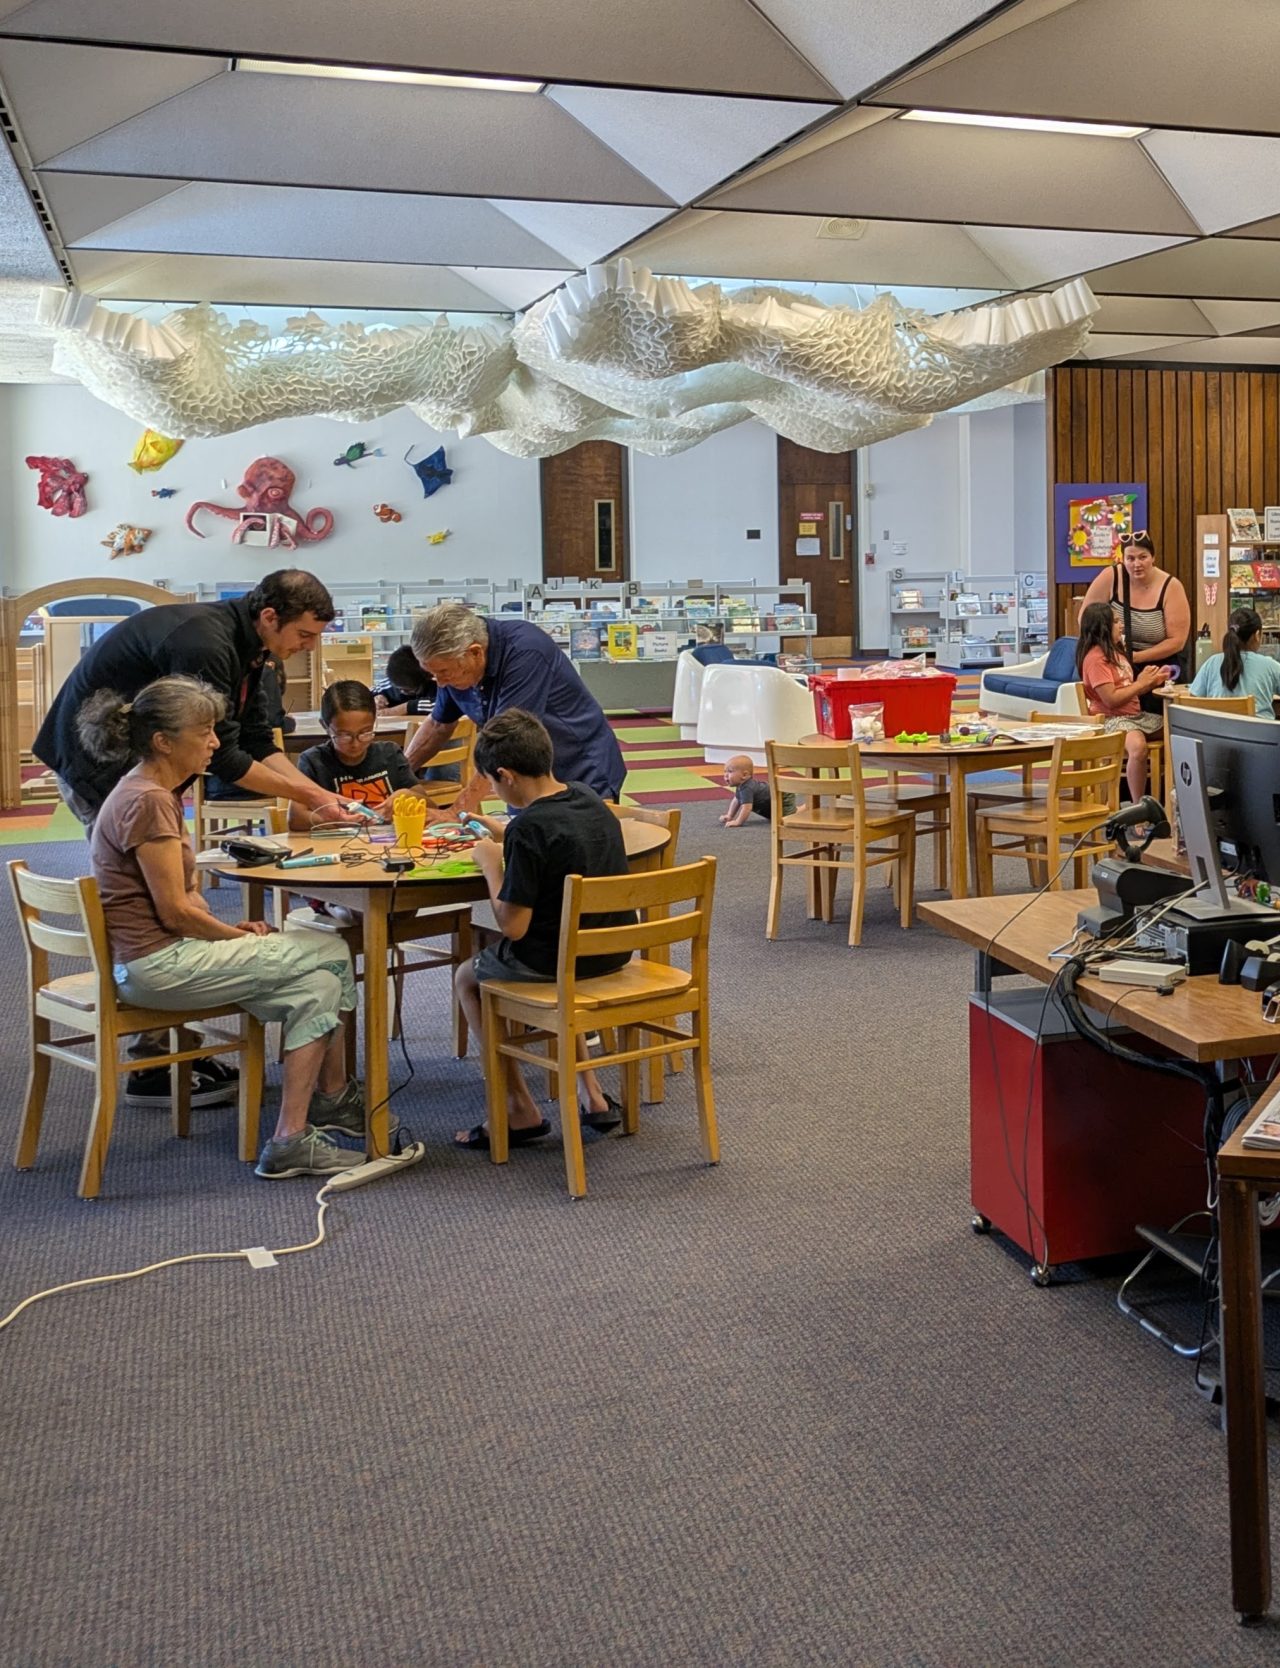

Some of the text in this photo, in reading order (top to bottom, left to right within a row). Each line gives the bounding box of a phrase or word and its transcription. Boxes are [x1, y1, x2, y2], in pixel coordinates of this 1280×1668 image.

[895, 569, 903, 579] S
[955, 573, 962, 582] L
[551, 580, 558, 590] J
[590, 580, 599, 589] K
[1024, 575, 1034, 586] C
[531, 586, 542, 598] A
[628, 583, 638, 595] B
